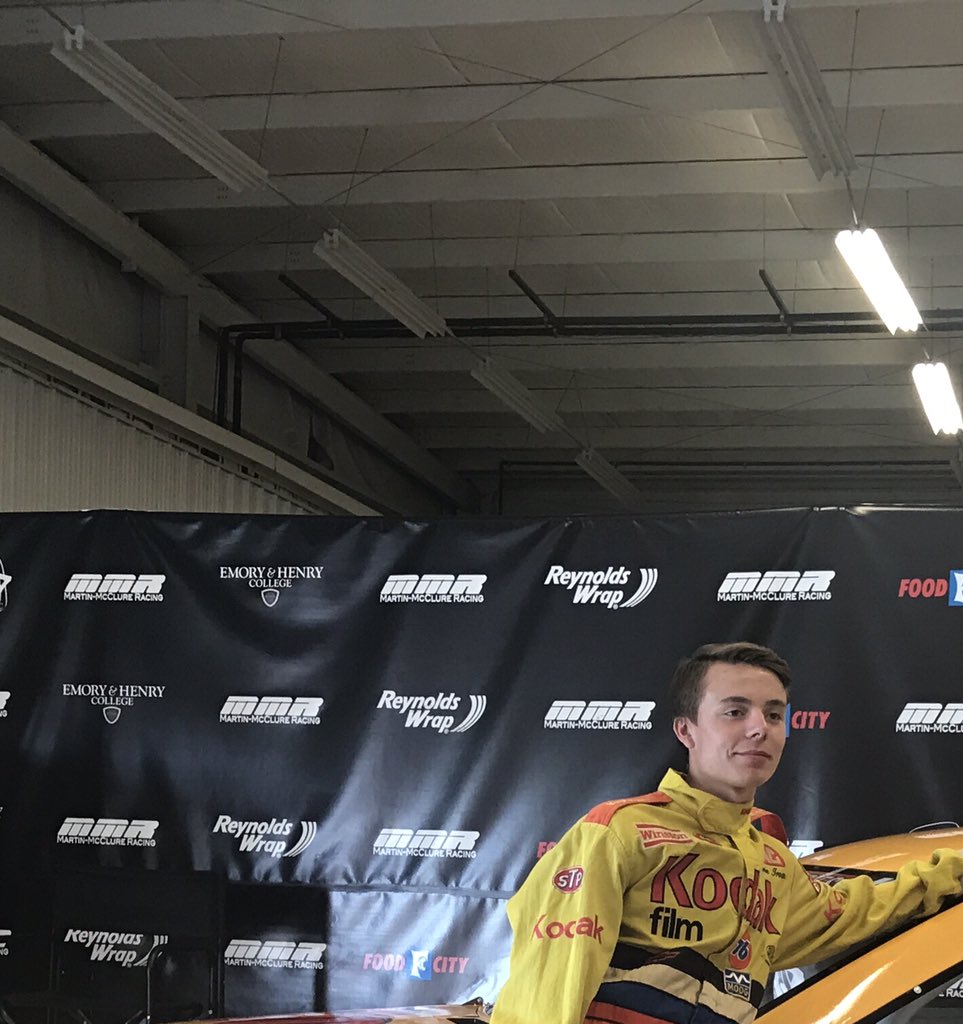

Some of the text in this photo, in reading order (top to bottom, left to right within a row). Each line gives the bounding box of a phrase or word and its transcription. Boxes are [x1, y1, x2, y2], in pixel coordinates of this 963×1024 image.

[220, 566, 324, 579] EMORY & HENRY
[544, 565, 631, 587] Reynolds
[248, 578, 293, 588] COLLEGE
[898, 578, 948, 598] FOOD
[134, 593, 163, 602] RACING
[454, 594, 484, 604] RACING
[573, 584, 624, 609] Wrap
[798, 591, 832, 602] RACING
[63, 684, 166, 698] EMORY & HENRY
[90, 696, 134, 706] COLLEGE
[377, 690, 461, 712] Reynolds
[292, 715, 321, 725] RACING
[404, 710, 455, 733] Wrap
[621, 720, 652, 730] RACING
[791, 710, 831, 729] CITY
[213, 815, 293, 836] Reynolds
[126, 837, 156, 847] RACING
[239, 834, 288, 858] Wrap
[446, 849, 477, 859] RACING
[556, 868, 584, 892] STP
[650, 853, 781, 935] Kodak
[650, 906, 703, 941] film
[90, 942, 138, 968] Wrap
[363, 953, 469, 974] FOOD CITY
[294, 960, 324, 969] RACING
[728, 982, 750, 997] MOOG
